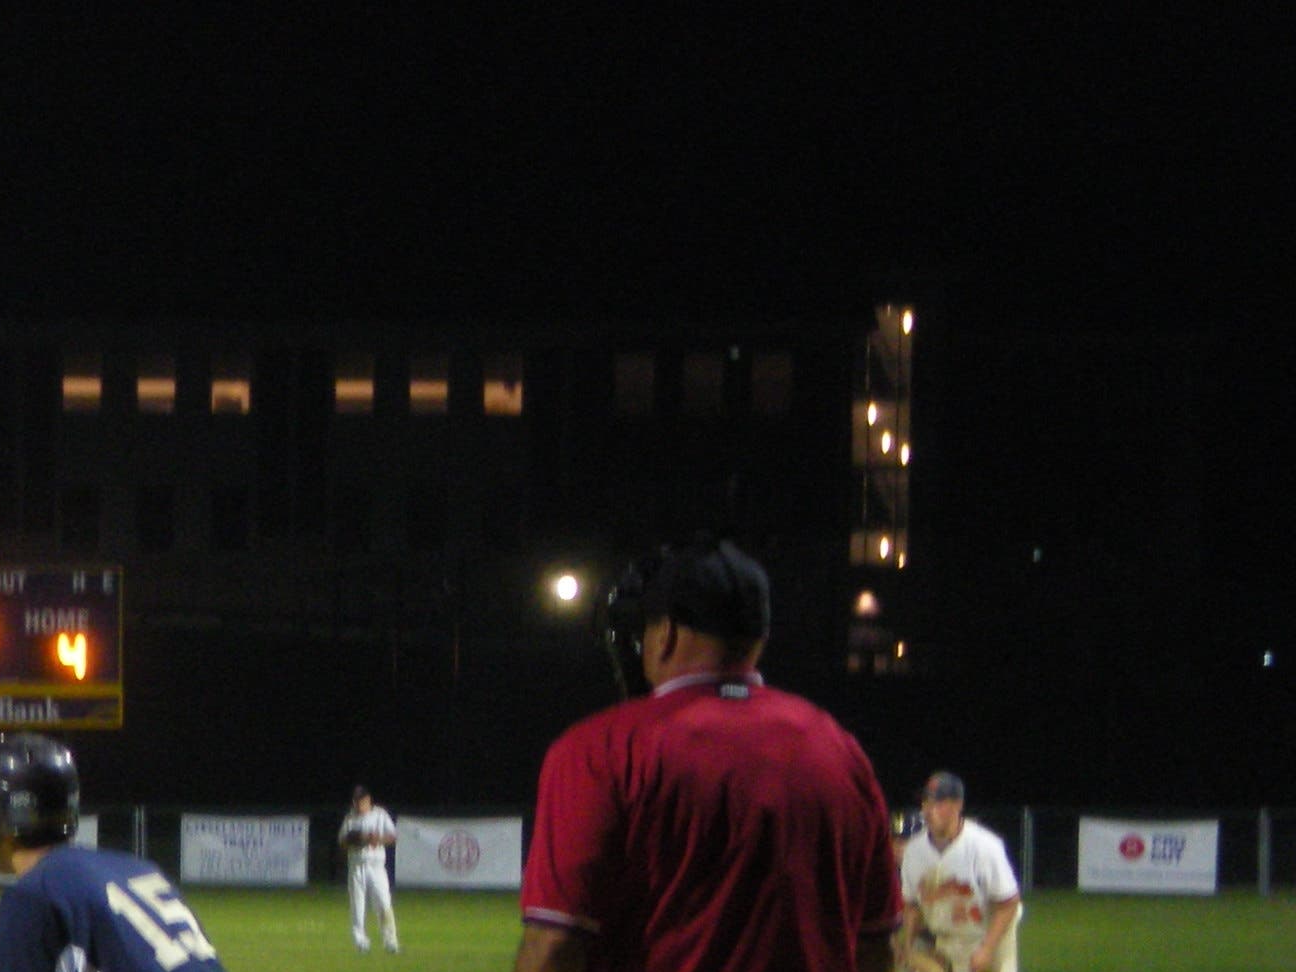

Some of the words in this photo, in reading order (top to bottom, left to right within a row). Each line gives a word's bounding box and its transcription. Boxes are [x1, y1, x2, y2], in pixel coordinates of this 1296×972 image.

[25, 607, 89, 634] HOME
[57, 632, 87, 681] 4
[106, 872, 217, 972] 15
